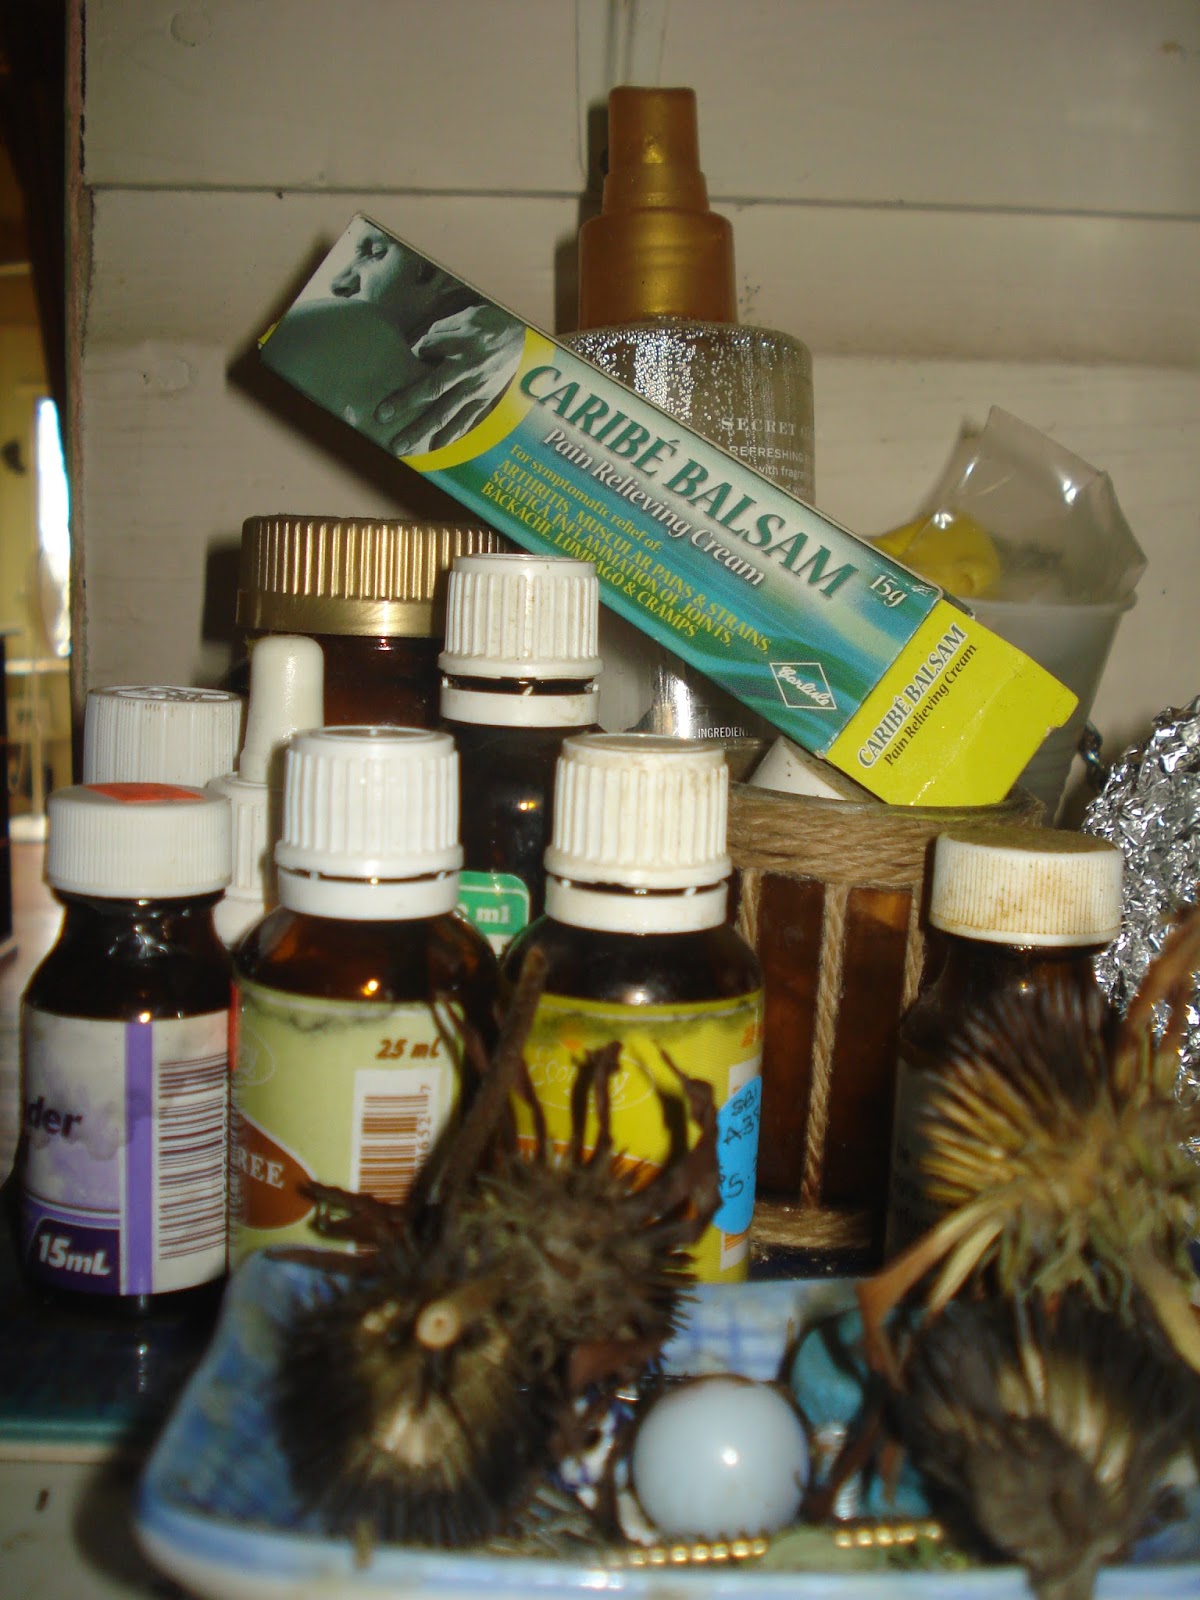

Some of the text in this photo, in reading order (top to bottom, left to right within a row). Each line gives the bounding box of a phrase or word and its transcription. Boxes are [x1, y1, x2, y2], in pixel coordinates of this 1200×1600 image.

[520, 365, 859, 598] CARIBÉ BALSAM
[721, 416, 797, 436] SECRET
[729, 445, 804, 463] REFRESHING
[756, 464, 779, 476] with
[510, 444, 664, 554] For symptomatic relief of:
[543, 428, 765, 586] Pain Relieving Cream
[481, 481, 700, 637] BACKACHE, LUMBAGO & CRAMPS
[552, 512, 662, 593] INFLAMMATION
[660, 588, 683, 606] OF
[678, 602, 735, 647] JOINTS,
[575, 510, 653, 570] MUSCULAR
[652, 563, 695, 599] PAINS
[694, 593, 707, 608] &
[708, 602, 771, 654] STRAINS,
[869, 574, 909, 608] 15g
[858, 622, 968, 769] CARIBÉ BALSAM
[883, 644, 977, 767] Pain Relieving Cream
[375, 1037, 440, 1060] 25 ml
[38, 1233, 111, 1276] 15mL
